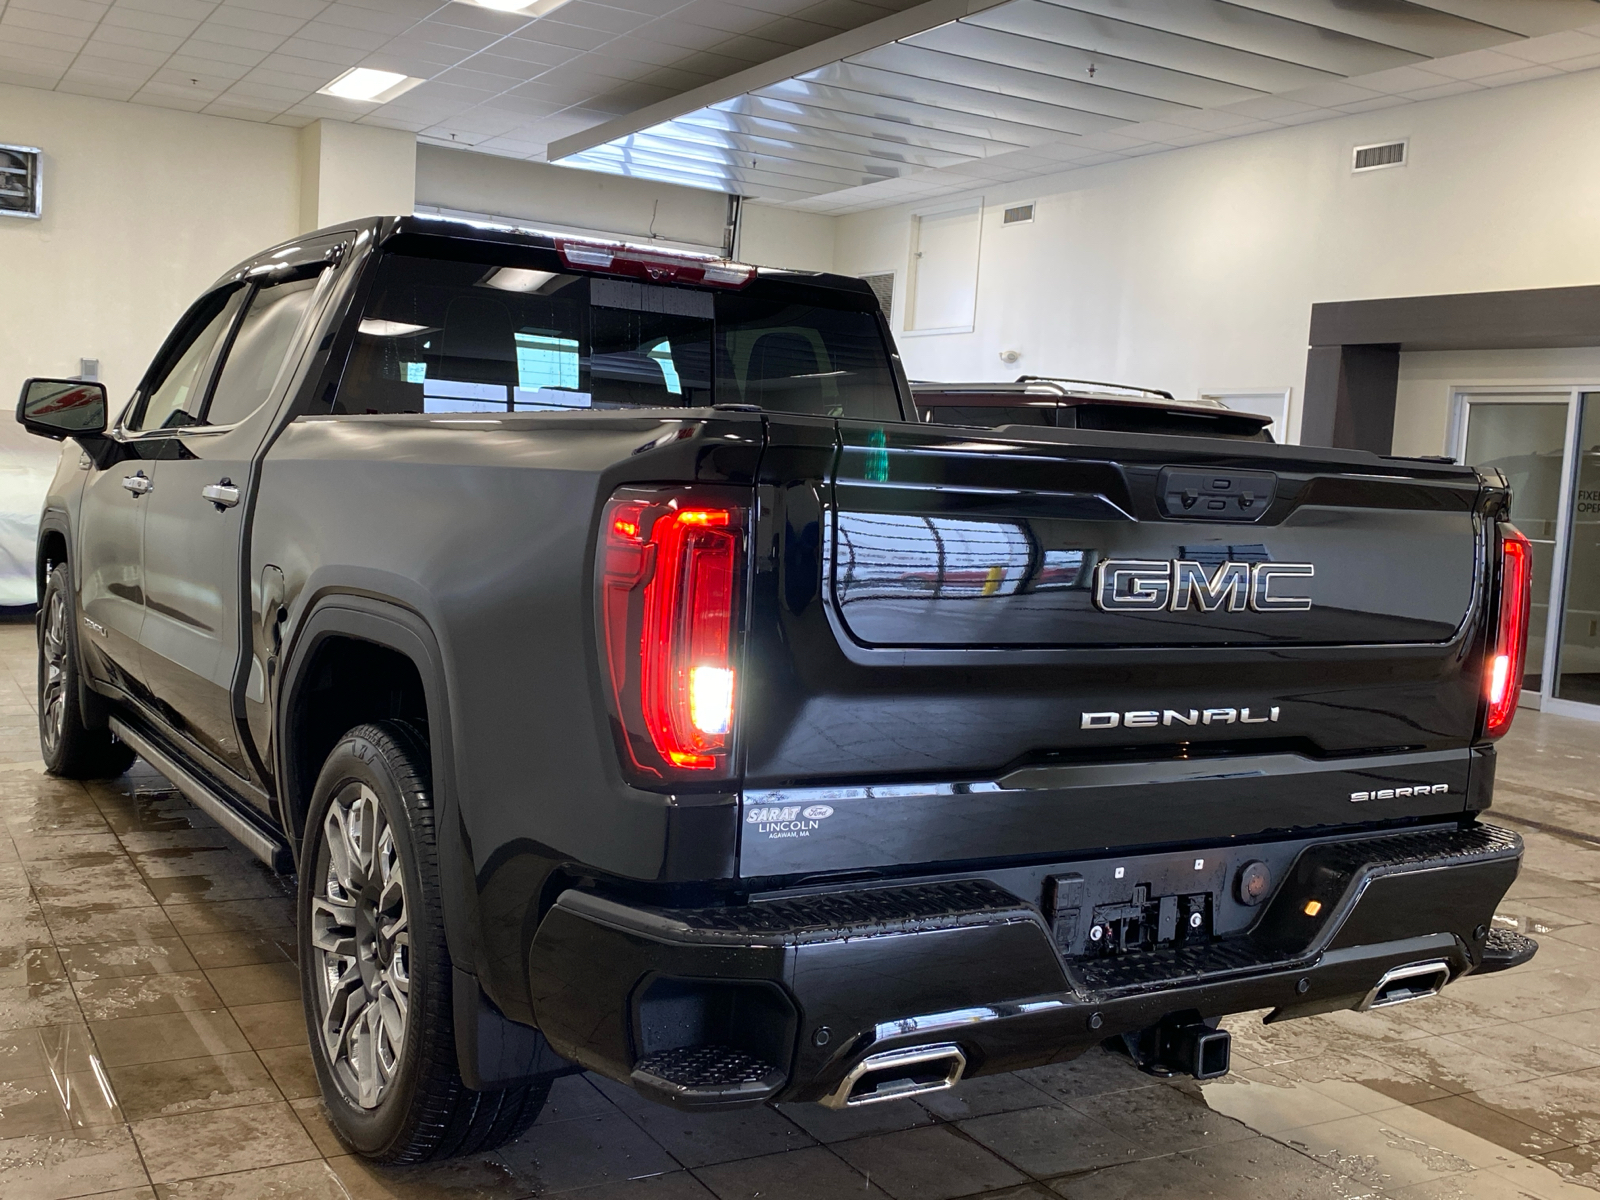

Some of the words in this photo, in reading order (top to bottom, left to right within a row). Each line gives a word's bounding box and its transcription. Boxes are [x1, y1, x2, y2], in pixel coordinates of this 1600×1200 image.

[1578, 490, 1600, 501] FIXE
[1093, 558, 1314, 613] GMC
[1080, 706, 1280, 730] DENALI
[1350, 783, 1449, 803] SIERRA
[746, 806, 802, 824] SARAT
[758, 820, 819, 833] LINCOLN
